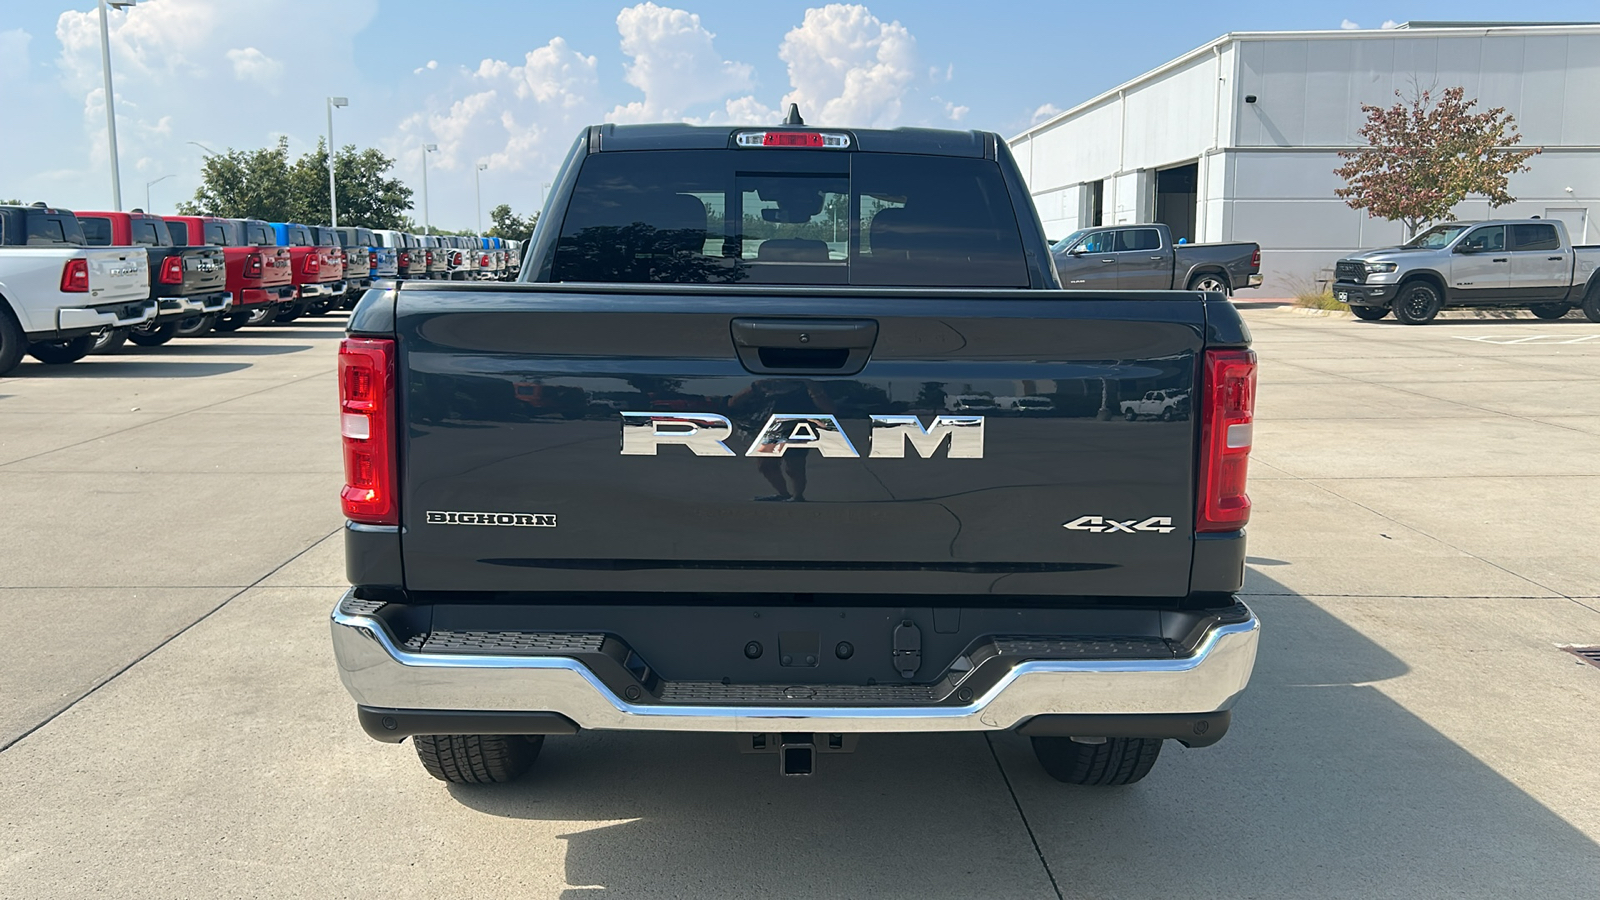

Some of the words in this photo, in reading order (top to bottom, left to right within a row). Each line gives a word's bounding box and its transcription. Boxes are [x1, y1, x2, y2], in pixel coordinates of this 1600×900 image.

[620, 411, 985, 459] RAM
[426, 511, 557, 527] BIGHORN
[1063, 516, 1176, 533] 4x4
